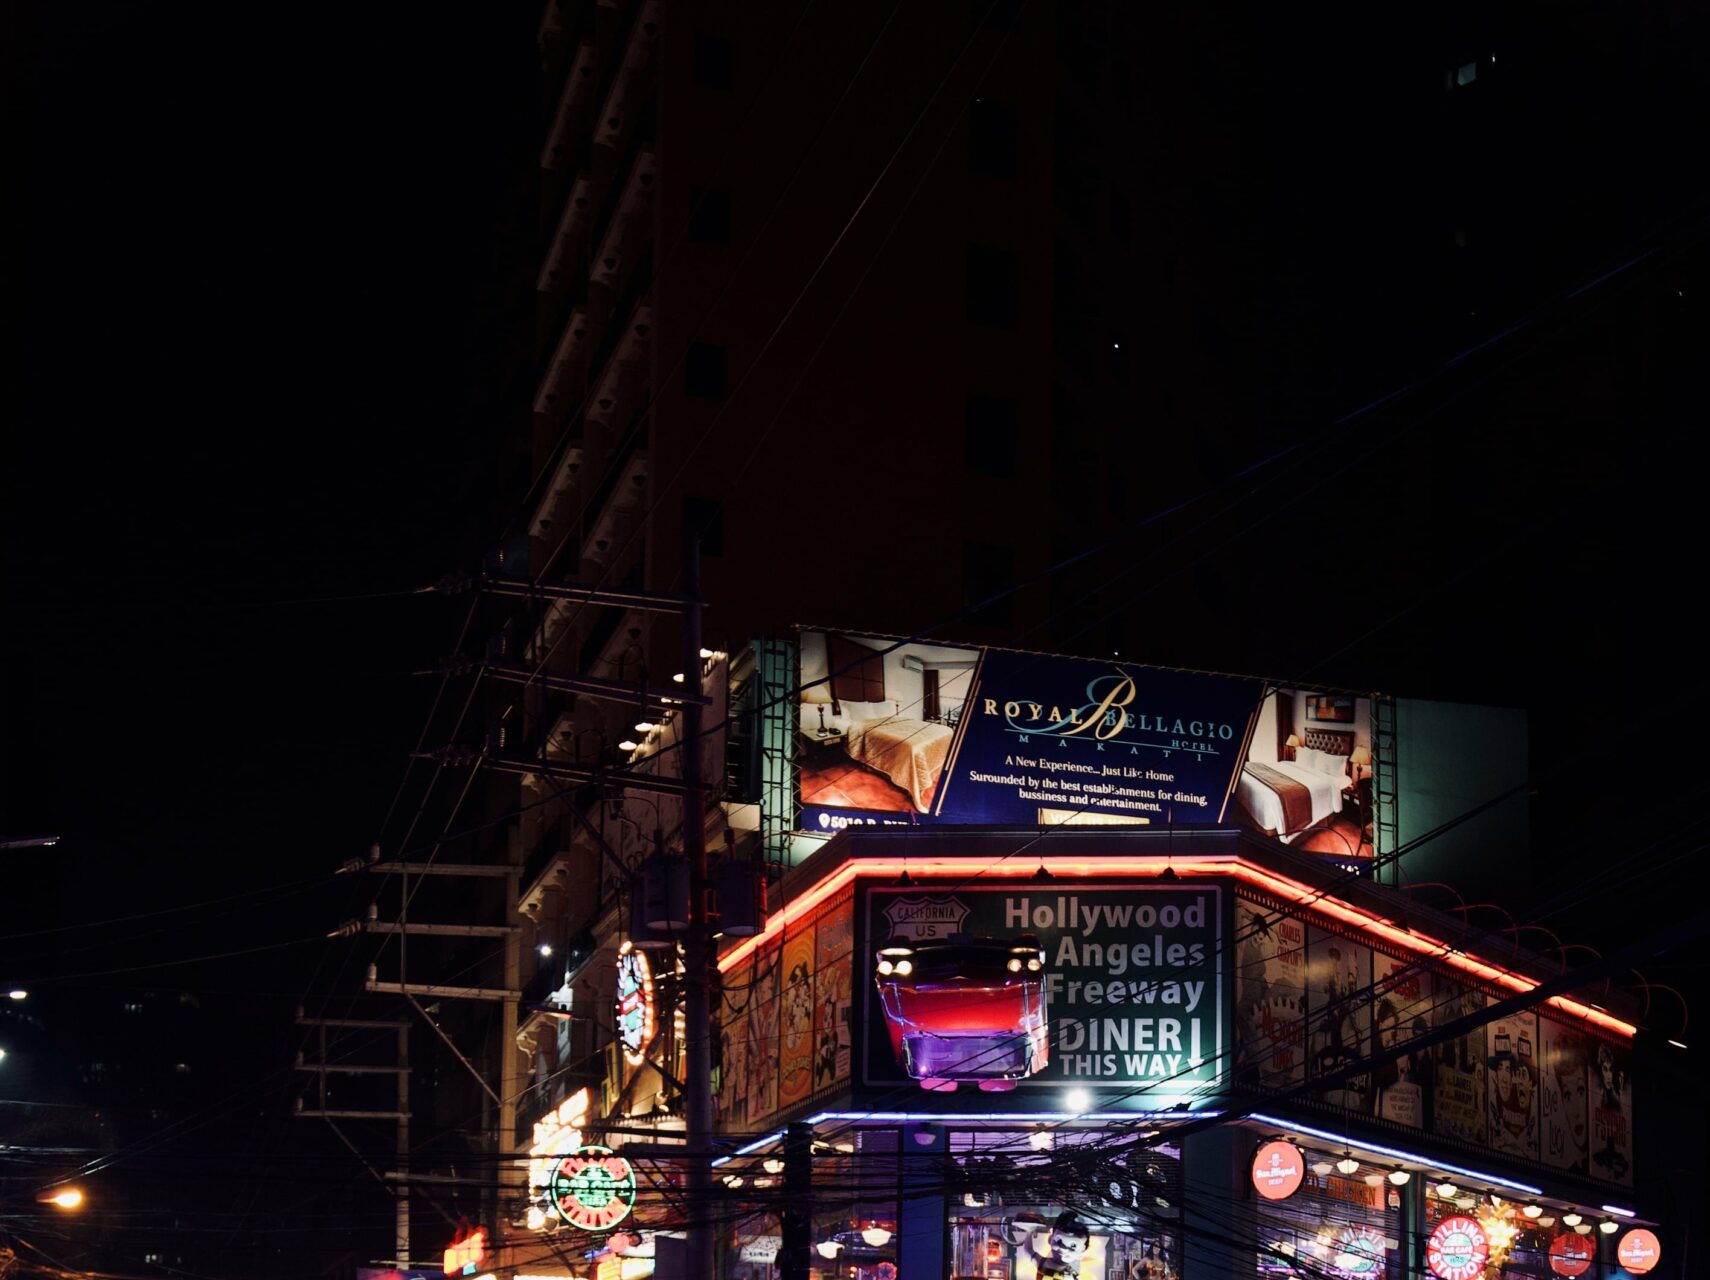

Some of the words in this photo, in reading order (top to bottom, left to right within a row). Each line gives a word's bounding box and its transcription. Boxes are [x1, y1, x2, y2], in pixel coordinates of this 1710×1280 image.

[984, 699, 1083, 724] ROYAL
[1104, 710, 1233, 740] BELLAGIO
[1019, 734, 1202, 761] MAKATI
[1171, 740, 1214, 752] HOTEL
[1005, 755, 1013, 765] A
[1015, 756, 1037, 768] New
[1101, 765, 1121, 778] Just
[1123, 767, 1143, 779] Like
[1145, 770, 1174, 782] Home
[969, 770, 1025, 786] Surounded
[1028, 777, 1040, 790] by
[1042, 778, 1058, 789] the
[1061, 779, 1080, 791] best
[1158, 789, 1172, 800] for
[1019, 788, 1067, 802] bussiness
[1069, 793, 1088, 805] and
[897, 906, 956, 920] CALIFORNIA
[1005, 897, 1205, 936] Hollywood
[915, 925, 937, 937] US
[1055, 935, 1204, 974] Angeles
[1047, 973, 1205, 1013] Freeway
[1059, 1018, 1182, 1052] DINER
[1059, 1054, 1116, 1076] THIS
[1124, 1054, 1181, 1076] WAY
[1429, 1219, 1485, 1248] FILLING
